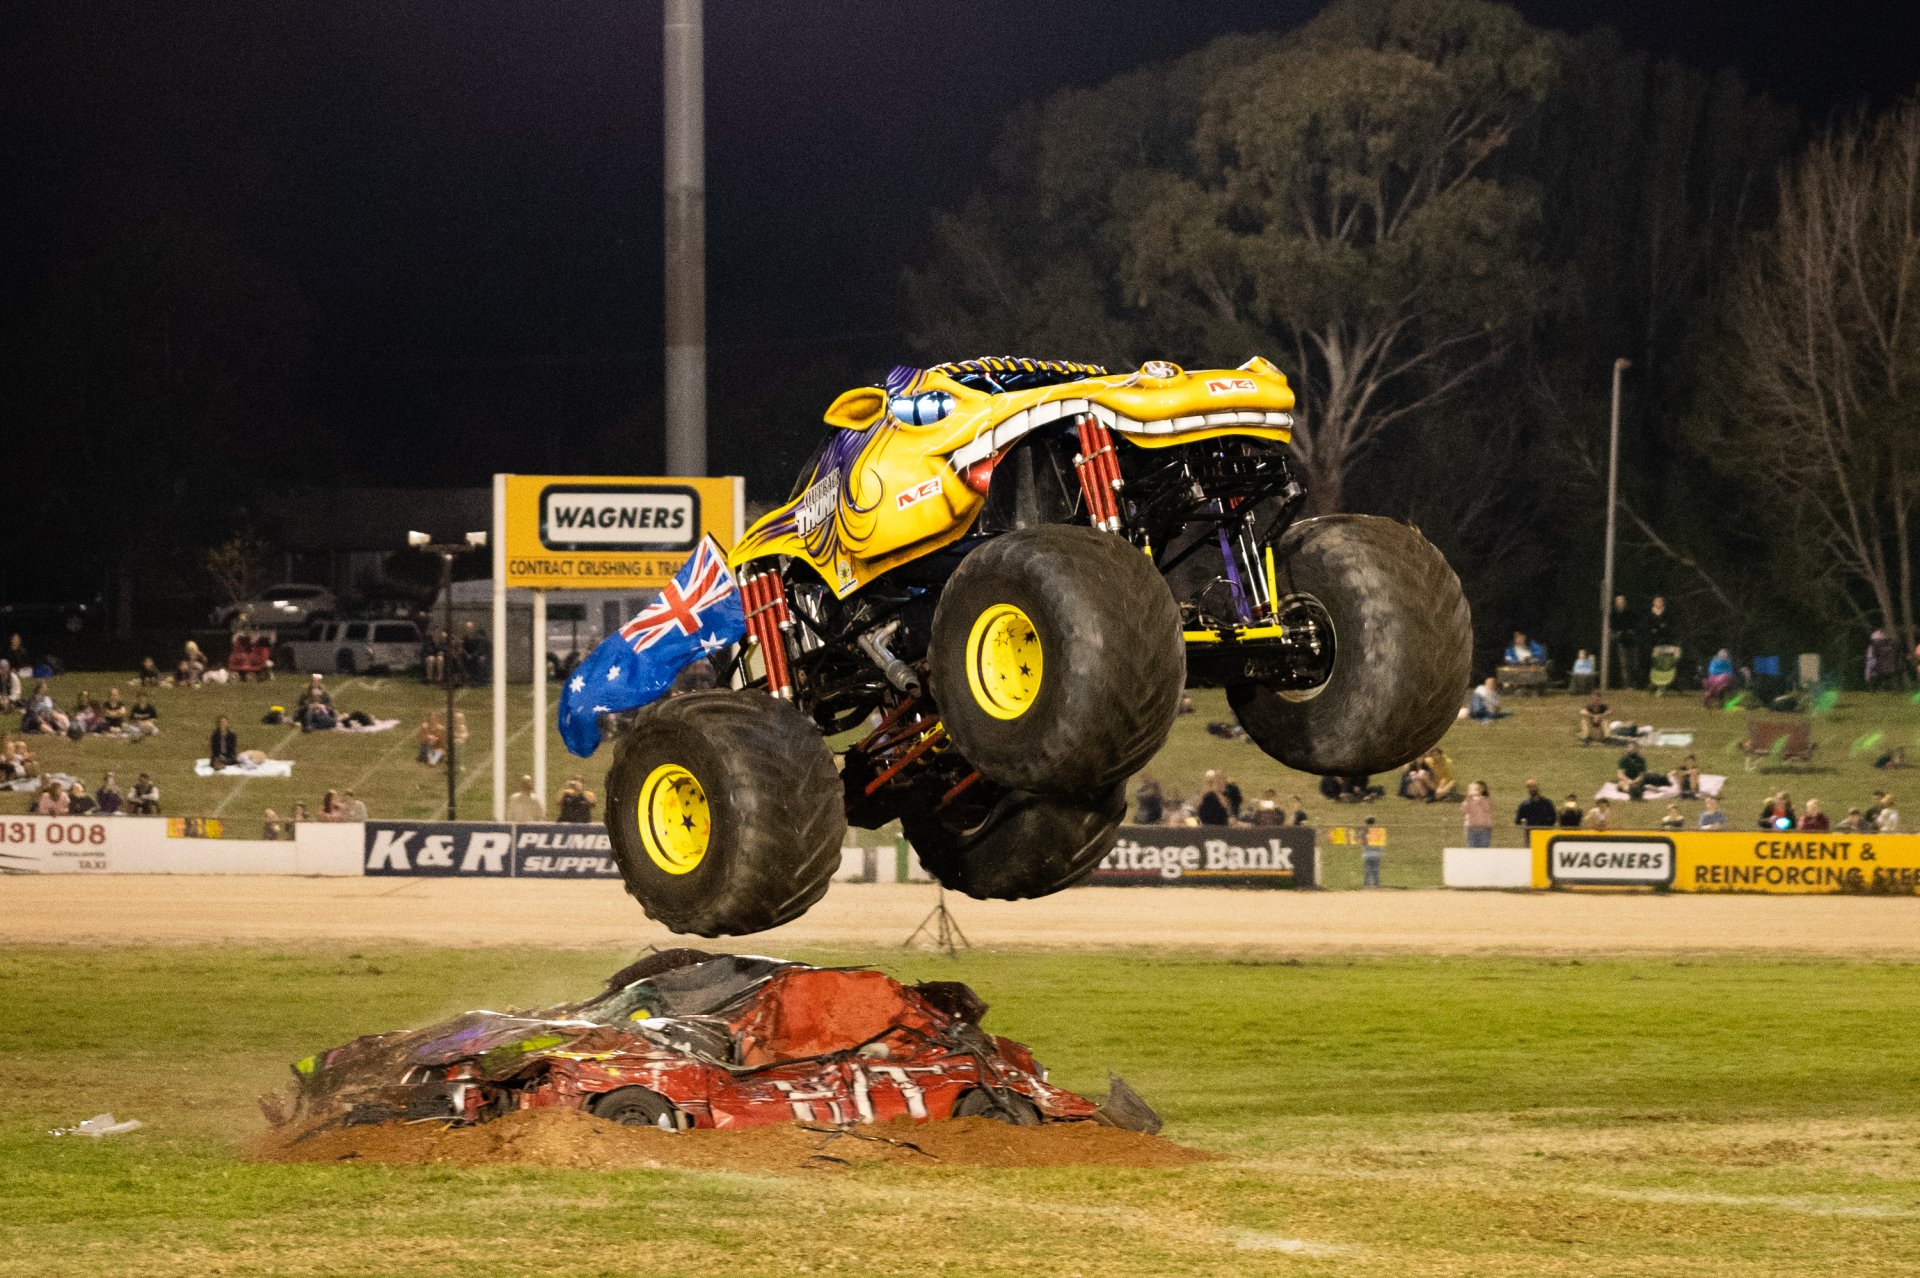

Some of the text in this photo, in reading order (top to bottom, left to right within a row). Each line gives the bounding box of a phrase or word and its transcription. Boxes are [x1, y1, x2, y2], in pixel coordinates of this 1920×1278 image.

[554, 506, 686, 529] WAGNERS
[509, 559, 684, 576] CONTRACT CRUSHING & TRA
[0, 822, 106, 845] 131 008
[367, 830, 511, 872] K & R
[1204, 838, 1293, 870] Bank
[1559, 851, 1663, 869] WAGNERS
[1754, 841, 1876, 861] CEMENT &
[1695, 865, 1864, 886] REINFORCING
